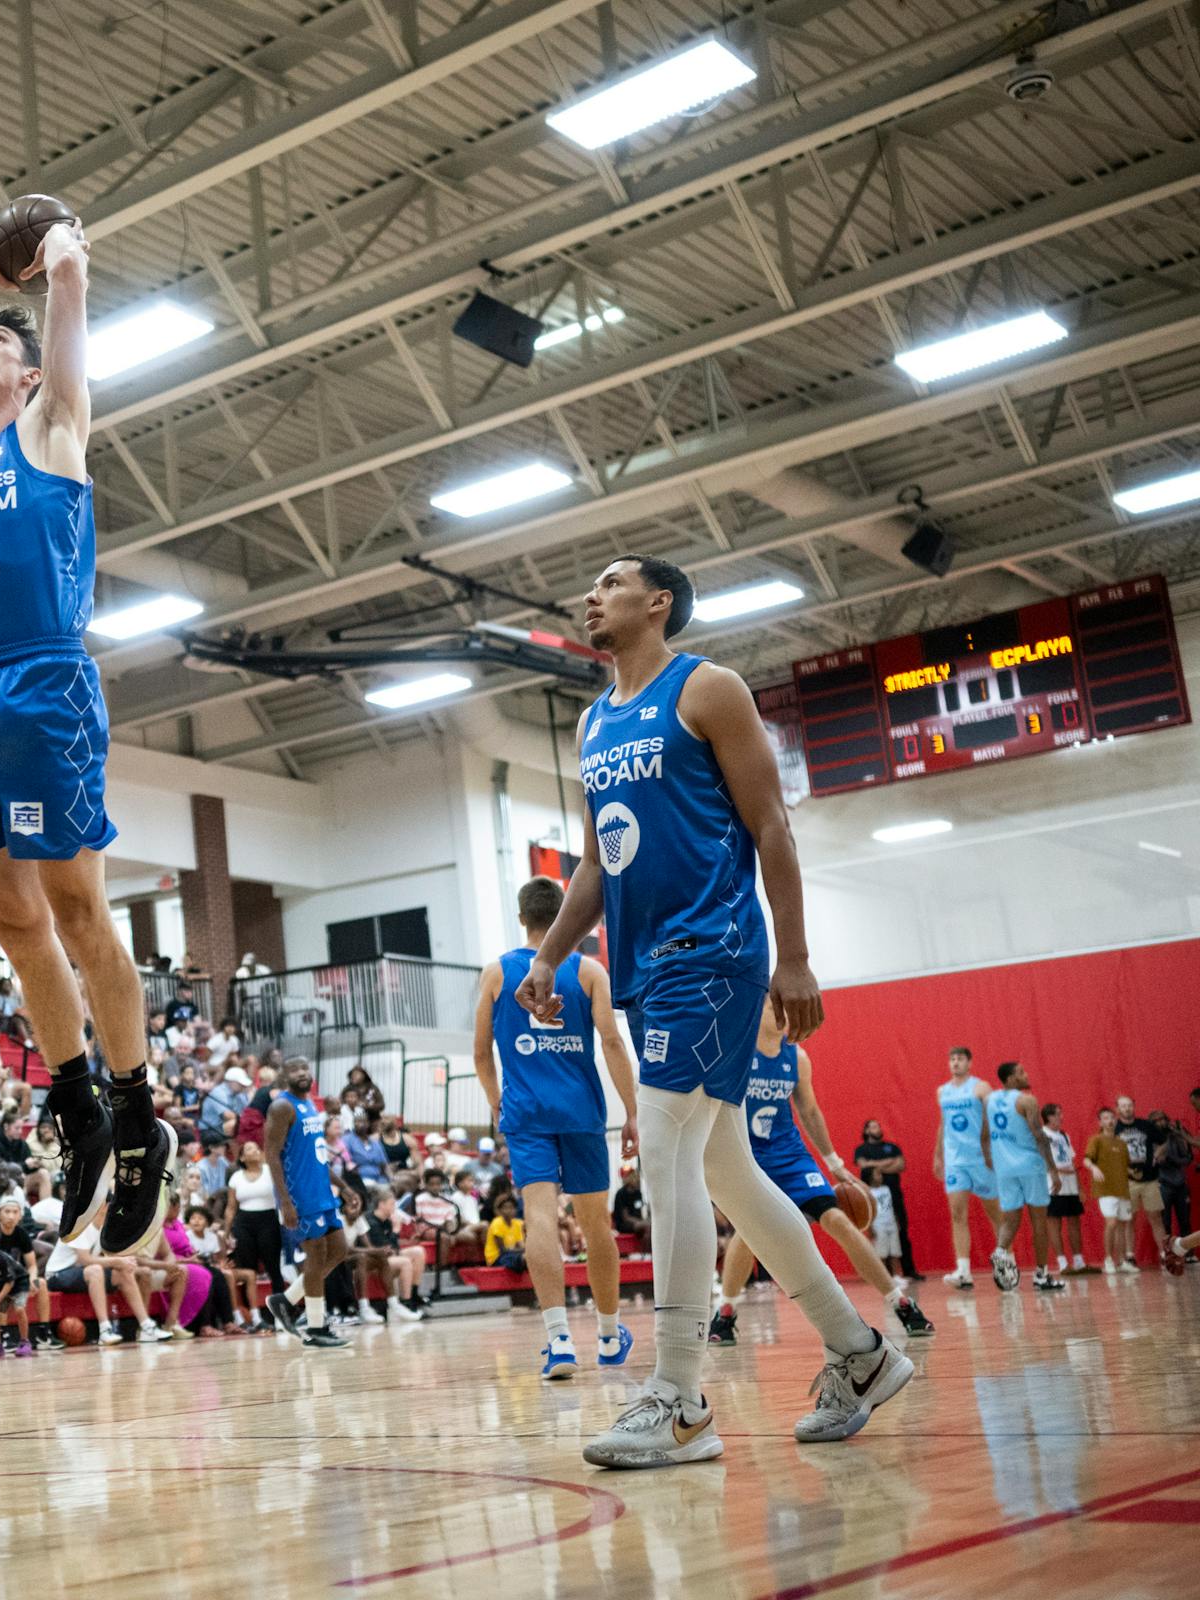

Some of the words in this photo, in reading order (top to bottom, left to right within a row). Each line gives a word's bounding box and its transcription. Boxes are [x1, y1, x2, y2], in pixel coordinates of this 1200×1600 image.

[989, 635, 1073, 670] ECPLAYA
[883, 662, 951, 694] STRICTLY
[1047, 688, 1079, 706] FOULS
[639, 705, 659, 721] 12
[890, 721, 920, 740] FOULS
[1053, 727, 1087, 746] SCORE
[608, 736, 665, 763] CITIES
[973, 744, 1006, 763] MATCH
[895, 760, 927, 778] SCORE
[538, 1042, 584, 1054] PRO-AM
